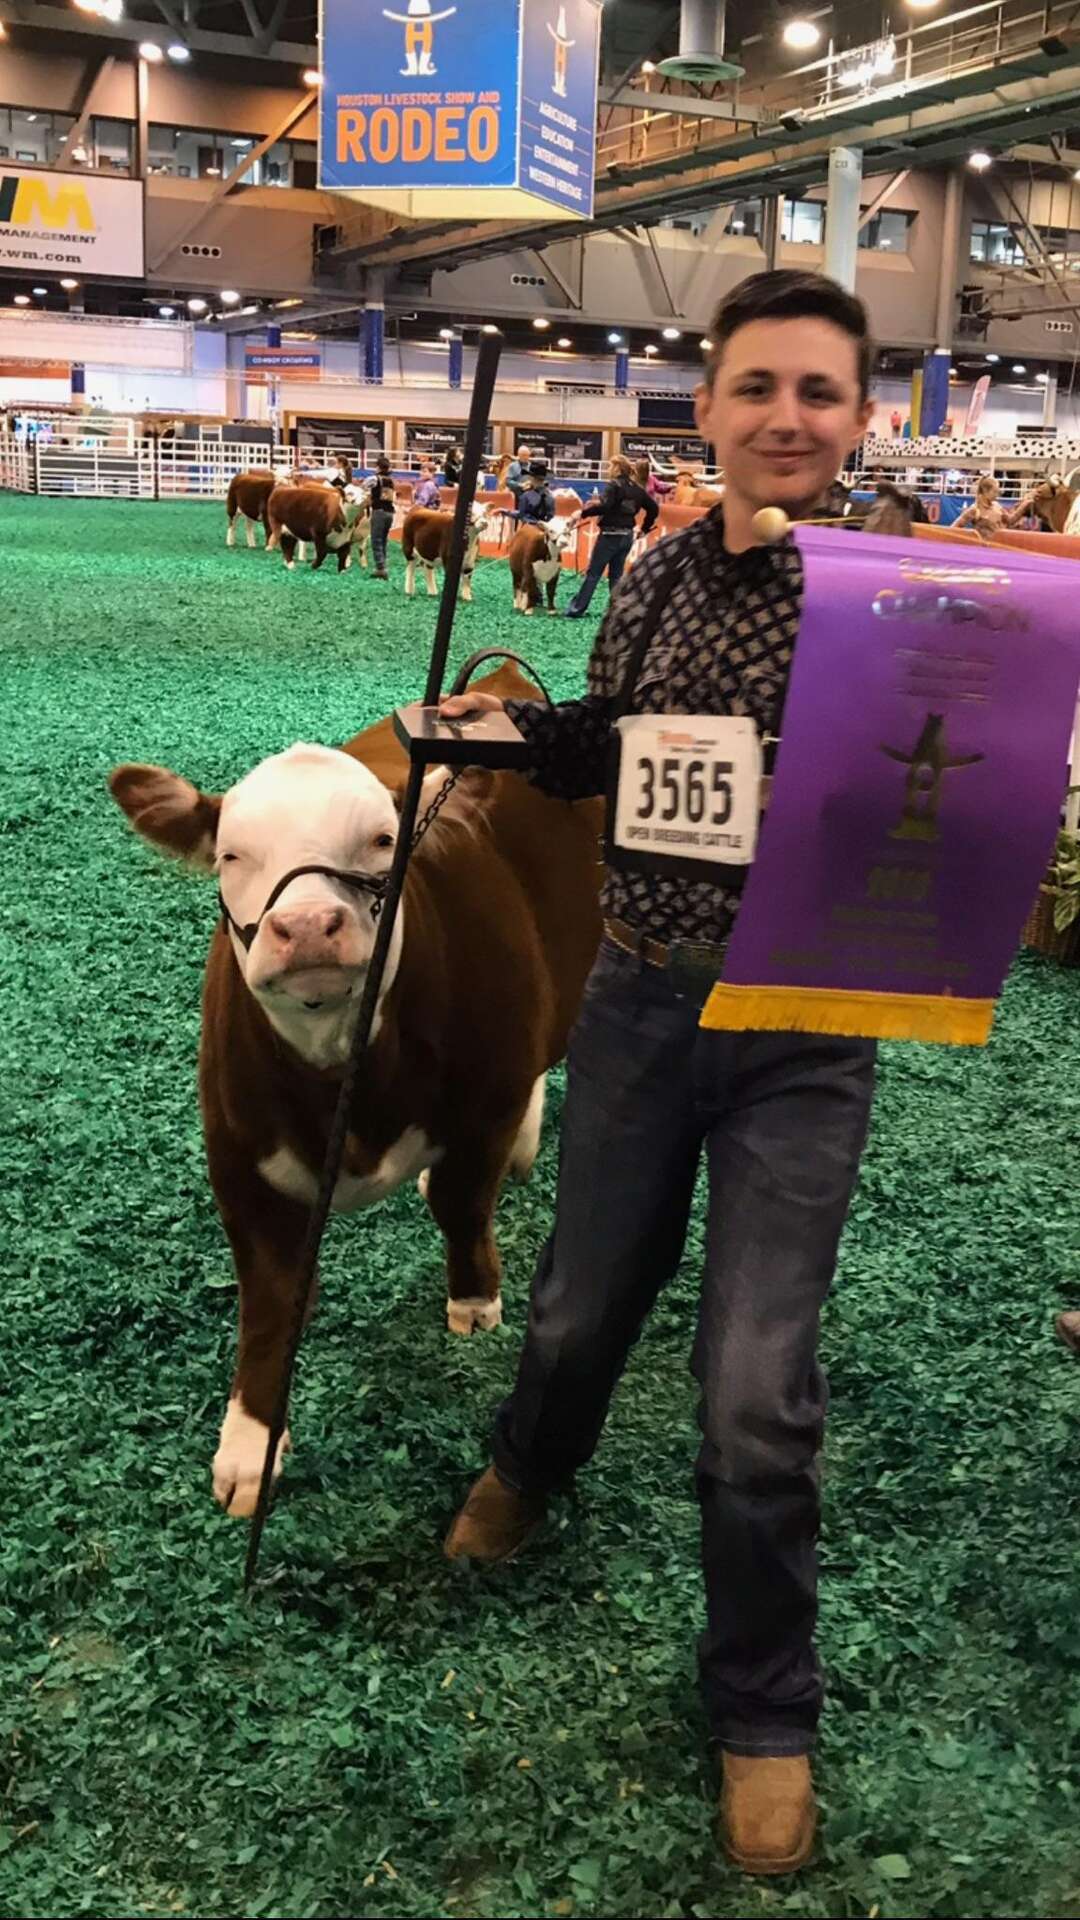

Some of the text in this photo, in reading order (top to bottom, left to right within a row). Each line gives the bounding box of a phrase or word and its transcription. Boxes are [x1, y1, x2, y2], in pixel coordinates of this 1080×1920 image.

[384, 92, 441, 105] LIVESTOCK
[445, 92, 474, 104] SHOW
[478, 91, 500, 103] AND
[336, 106, 499, 163] RODEO
[0, 228, 96, 244] MANAGEMENT
[636, 757, 734, 825] 3565
[626, 826, 742, 848] OPEN BREEDING CATTLE
